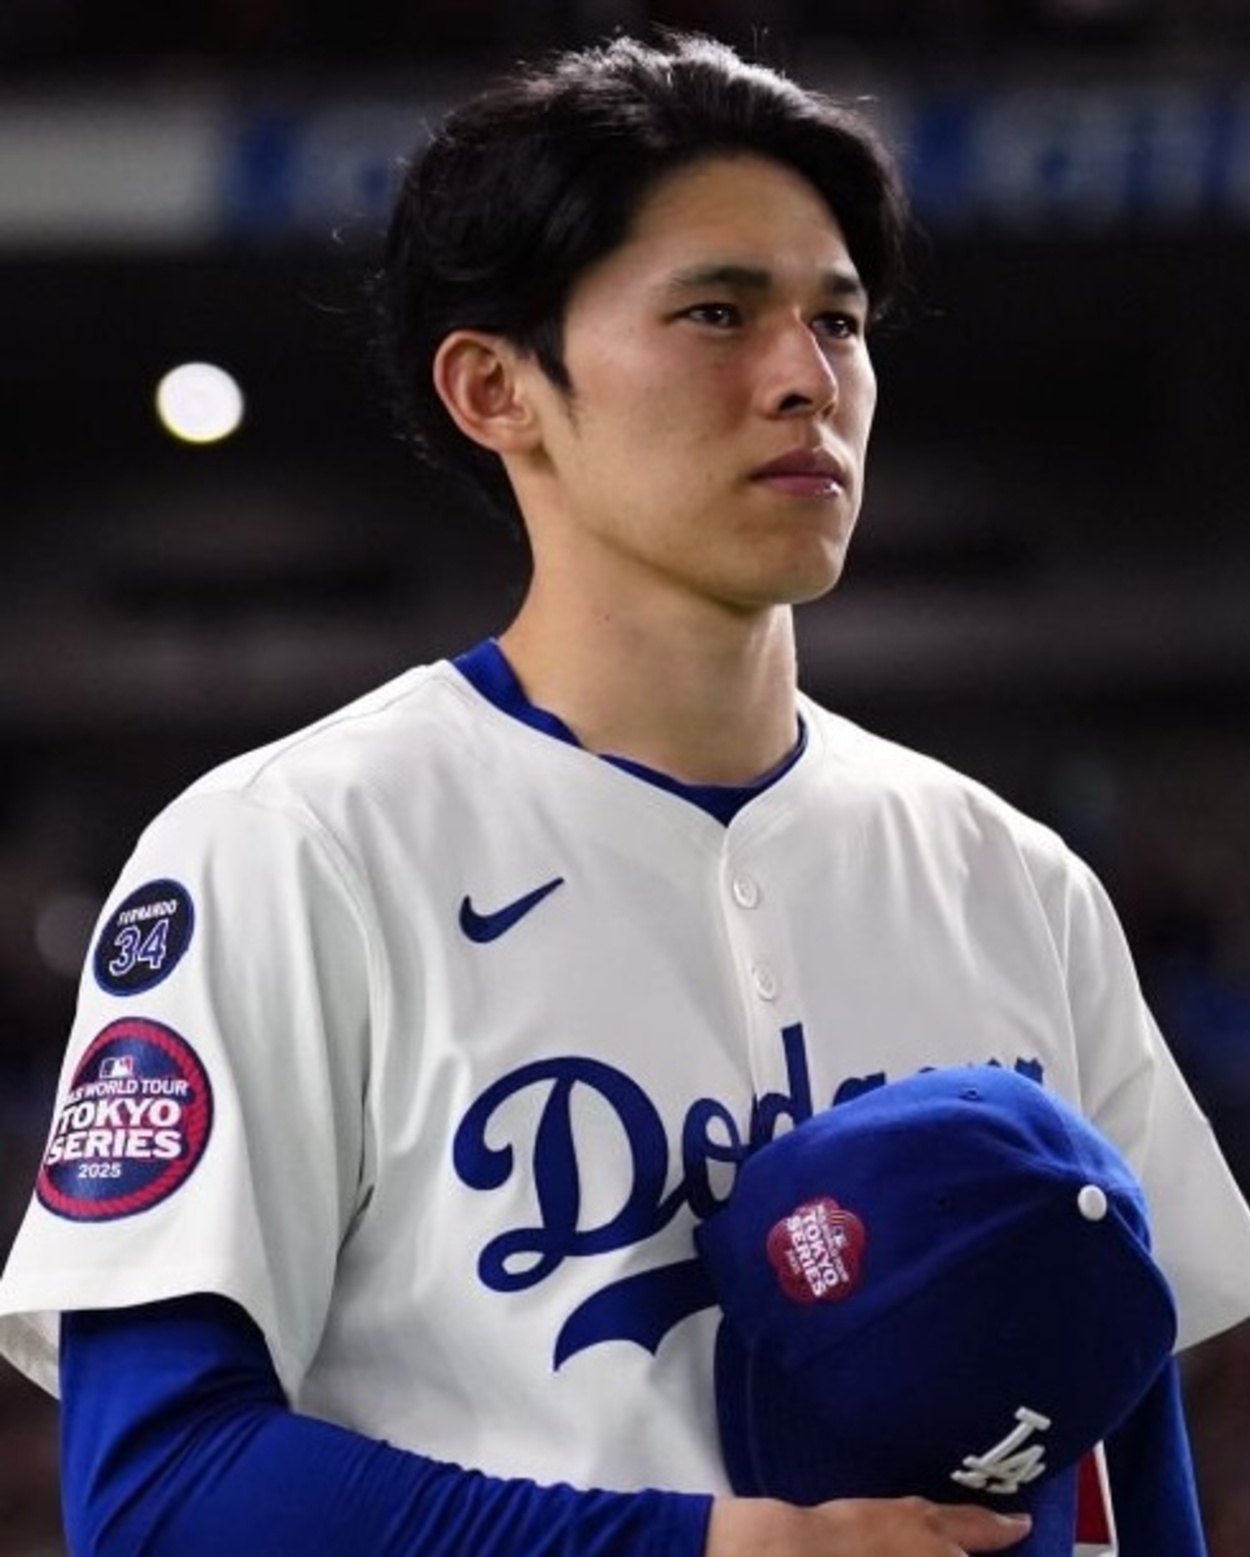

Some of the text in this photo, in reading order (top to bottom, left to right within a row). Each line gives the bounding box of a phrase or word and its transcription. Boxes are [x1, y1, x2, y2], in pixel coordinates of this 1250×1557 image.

[117, 899, 177, 926] FERNANDO
[109, 918, 169, 977] 34
[85, 1079, 138, 1097] WORLD
[141, 1079, 189, 1096] TOUR
[62, 1098, 182, 1134] TOKYO
[47, 1129, 182, 1166] SERIES
[78, 1163, 121, 1178] 2025
[787, 1214, 827, 1297] SERIES
[802, 1207, 839, 1287] TOKYO
[950, 1405, 1052, 1494] LA
